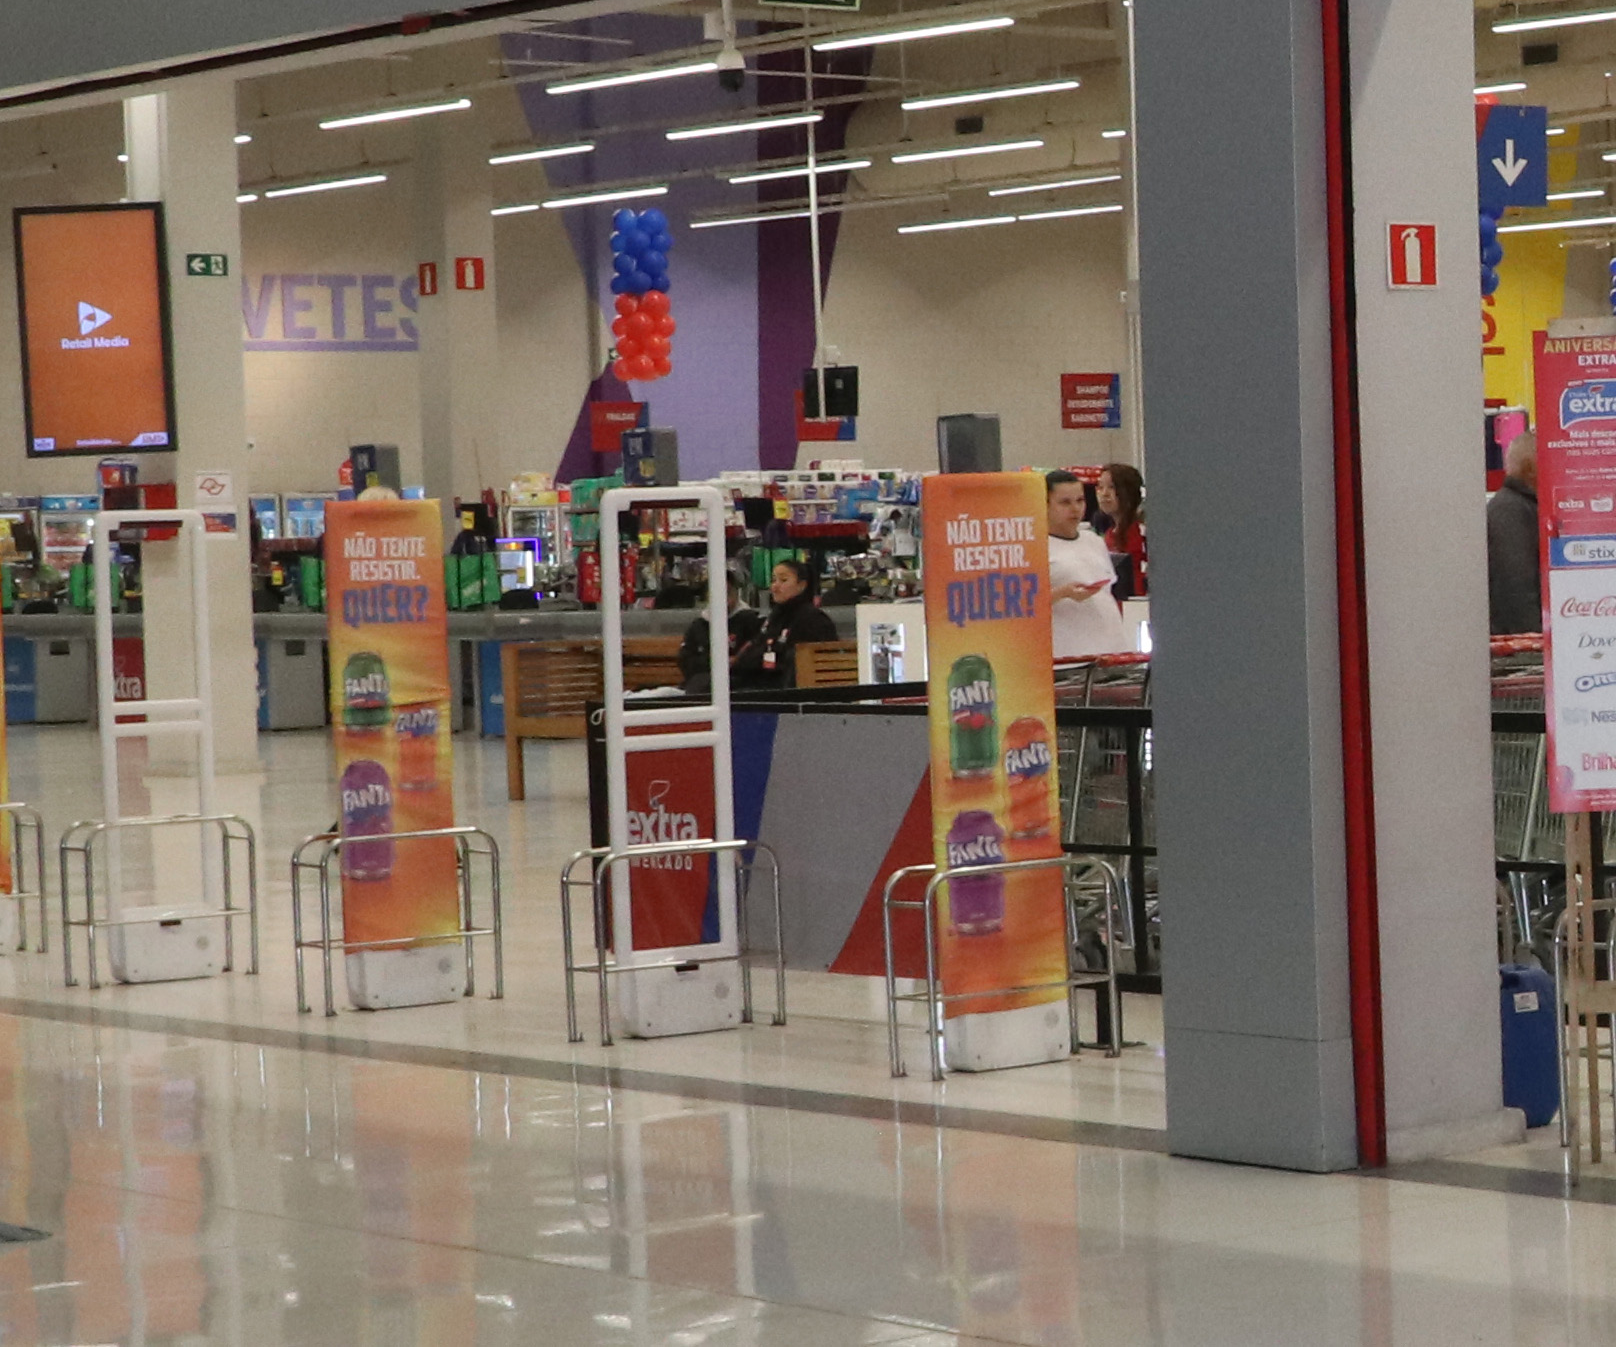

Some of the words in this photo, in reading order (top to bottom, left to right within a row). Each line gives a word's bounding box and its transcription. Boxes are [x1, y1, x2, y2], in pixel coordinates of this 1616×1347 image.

[60, 338, 93, 349] Retail
[94, 336, 130, 348] Media
[1558, 499, 1585, 514] extra
[947, 513, 981, 545] NÃO
[984, 517, 1035, 542] TENTE
[344, 531, 377, 559] NÃO
[381, 537, 427, 557] TENTE
[953, 544, 1030, 572] RESISTIR.
[1588, 545, 1615, 559] stix
[349, 560, 421, 582] RESISTIR.
[343, 583, 430, 628] QUER?
[946, 573, 1039, 628] QUER?
[1578, 633, 1616, 649] Dove
[115, 675, 143, 699] xtra
[627, 803, 698, 845] extra
